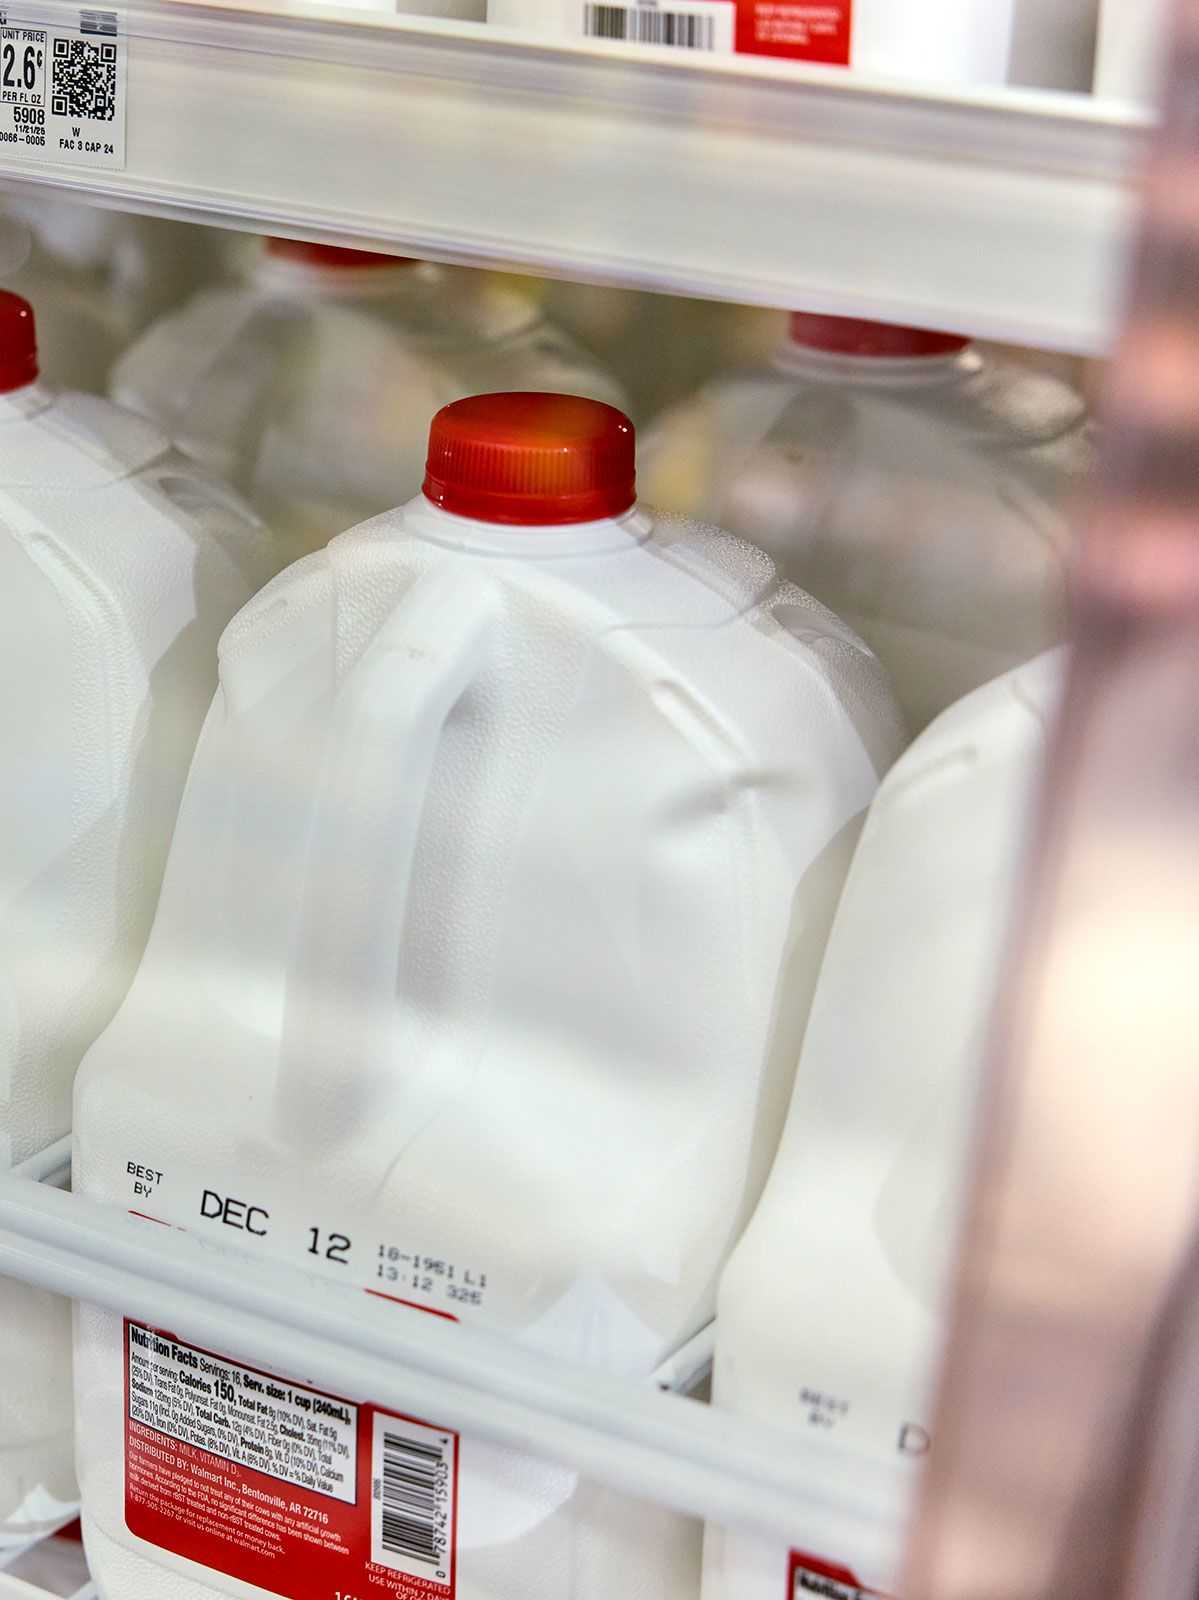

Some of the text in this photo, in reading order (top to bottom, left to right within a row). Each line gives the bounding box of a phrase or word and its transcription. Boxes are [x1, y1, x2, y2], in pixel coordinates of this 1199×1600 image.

[2, 31, 44, 43] UNIT PRICE
[2, 91, 41, 104] PER FL OZ
[13, 106, 45, 125] 5908
[72, 127, 80, 137] W
[60, 139, 74, 149] FAC
[85, 142, 101, 152] CAP
[104, 144, 113, 154] 24
[126, 1161, 163, 1184] BEST
[134, 1181, 152, 1198] BY
[200, 1190, 352, 1265] DEC 12
[171, 1344, 197, 1368] Facts
[199, 1357, 229, 1382] Servings:
[243, 1373, 263, 1393] Serv.
[266, 1381, 285, 1401] size:
[288, 1389, 291, 1403] 1
[294, 1394, 310, 1412] cup
[179, 1369, 211, 1394] Calories
[214, 1378, 236, 1405] 150,
[238, 1394, 255, 1410] Total
[256, 1401, 267, 1415] Fat
[132, 1377, 153, 1396] Sodium
[195, 1405, 211, 1421] Total
[213, 1412, 230, 1428] Carb.
[129, 1420, 177, 1451] INGREDIENTS:
[199, 1450, 229, 1472] VITAMIN
[240, 1436, 263, 1455] Protein
[129, 1434, 328, 1525] DISTRIBUTED BY: Walmart Inc., Bentonville, AR 72716
[435, 1462, 448, 1503] 15903
[160, 1497, 184, 1516] package
[185, 1507, 194, 1518] for
[196, 1512, 235, 1536] replacement
[433, 1510, 447, 1554] 78742
[205, 1524, 224, 1539] online
[233, 1536, 275, 1559] walmart.com
[365, 1561, 450, 1595] KEEP REFRIGERATED
[368, 1574, 385, 1587] USE
[386, 1581, 418, 1598] WITHIN
[436, 1570, 446, 1578] 0
